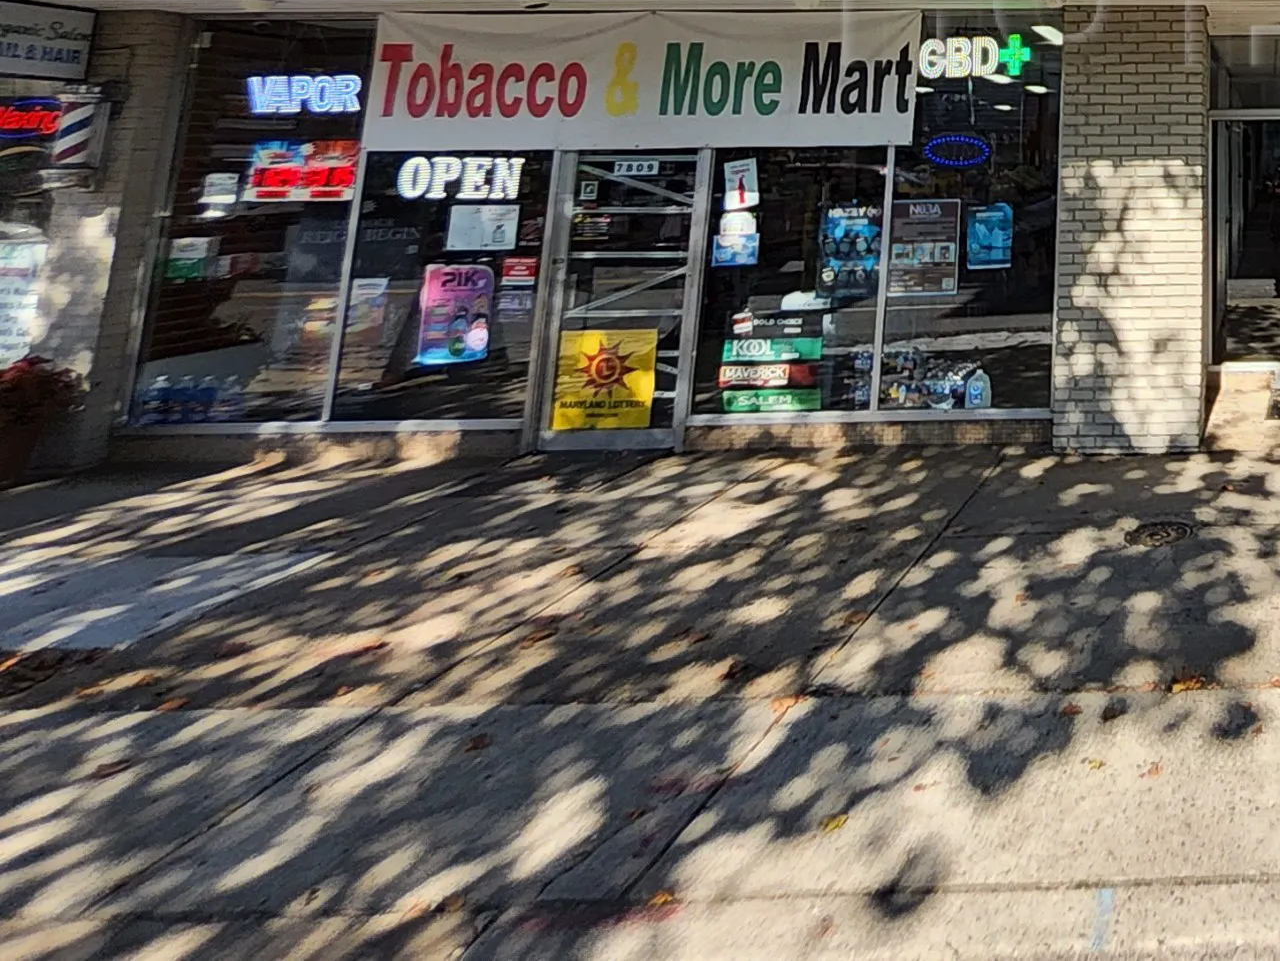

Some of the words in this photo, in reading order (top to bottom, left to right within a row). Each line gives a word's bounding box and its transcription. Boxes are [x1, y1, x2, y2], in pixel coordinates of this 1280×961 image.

[379, 43, 588, 119] Tobacco
[604, 41, 641, 118] &
[658, 41, 783, 116] More
[798, 41, 913, 115] Mart
[247, 74, 362, 114] VAPOR
[616, 163, 654, 173] 7809
[397, 156, 526, 200] OPEN
[732, 339, 775, 357] KOOL
[725, 366, 785, 379] MAVERICK
[559, 400, 606, 409] MARYLAND
[608, 400, 648, 408] LOTTERY
[736, 395, 793, 406] SALEM
